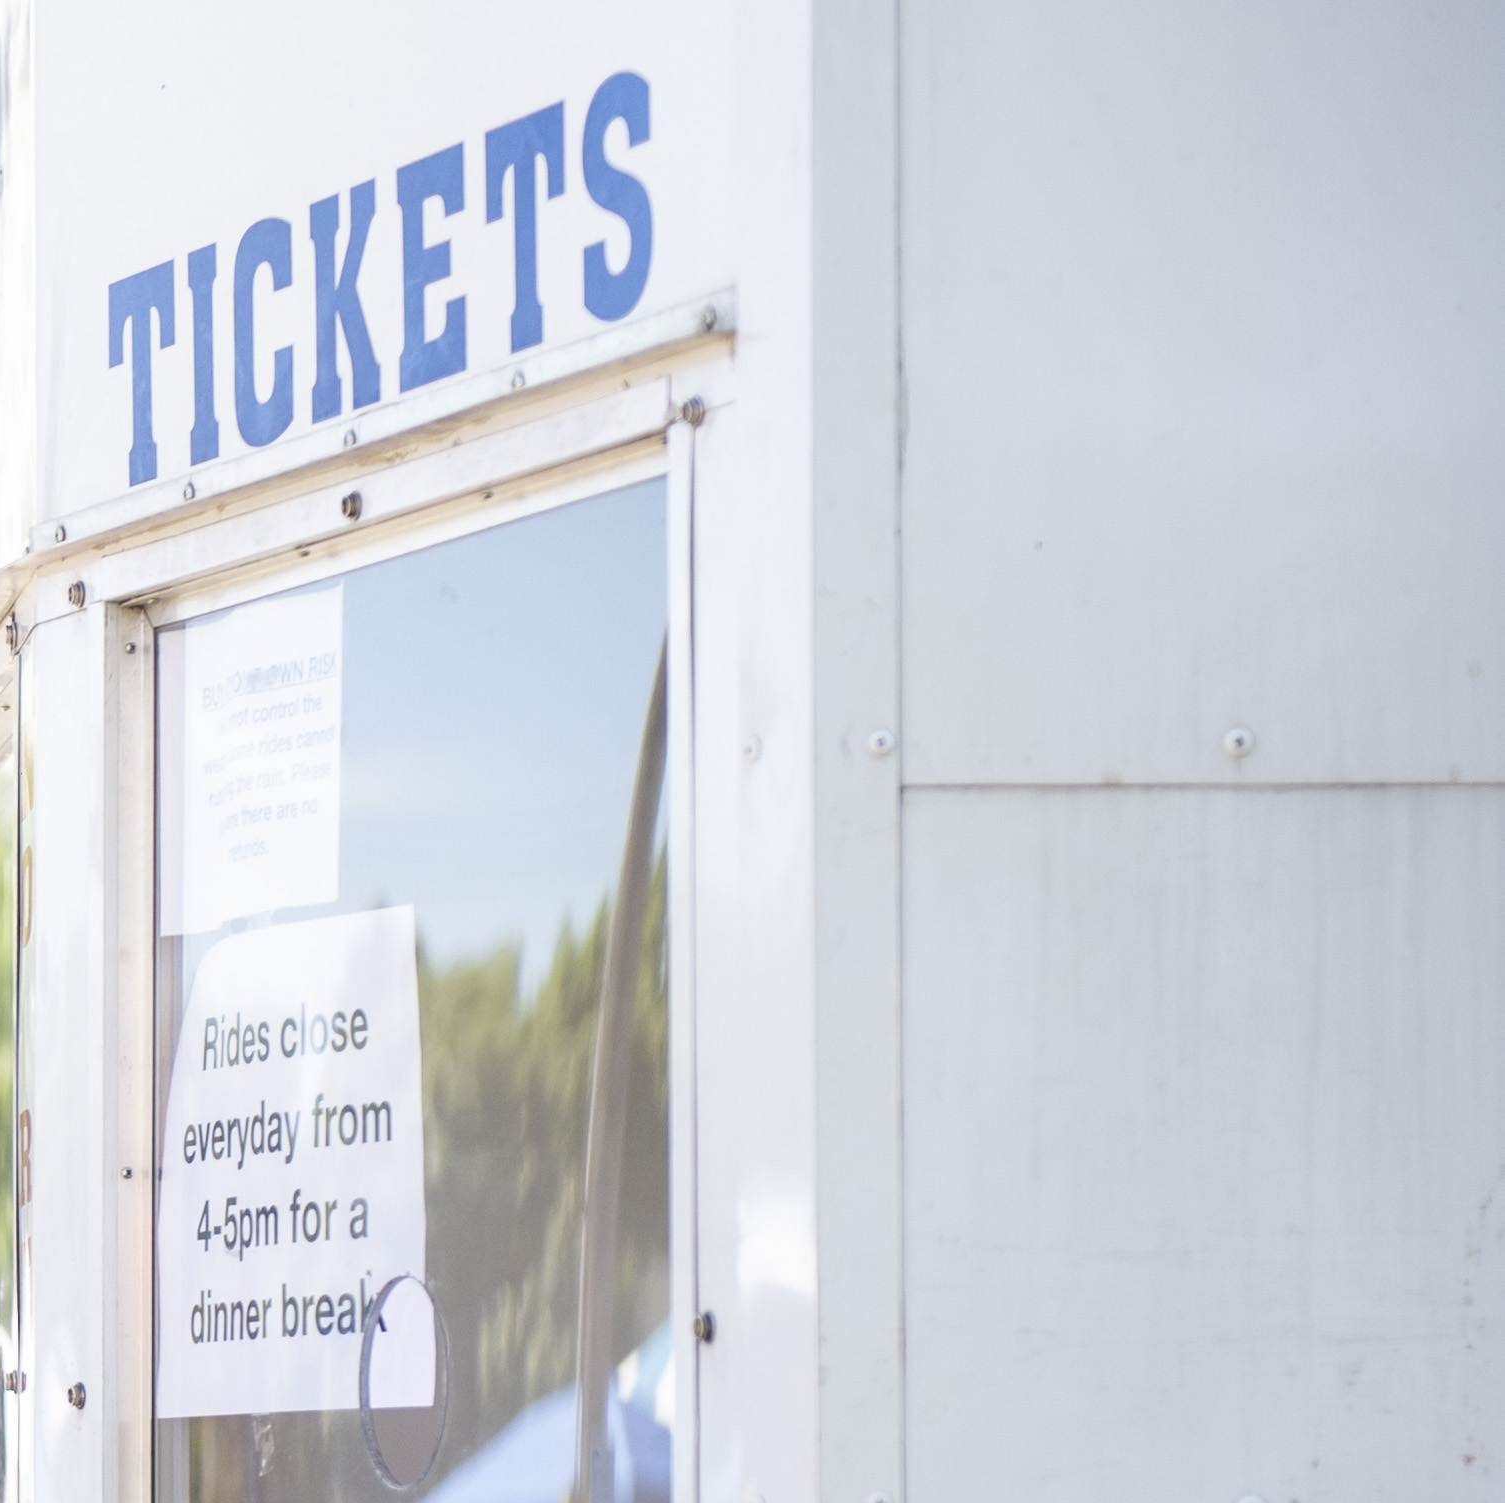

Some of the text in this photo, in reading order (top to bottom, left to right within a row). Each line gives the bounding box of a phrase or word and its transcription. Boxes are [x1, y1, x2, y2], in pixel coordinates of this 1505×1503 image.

[108, 69, 653, 488] TICKETS
[252, 696, 299, 724] control
[303, 693, 323, 714] the
[259, 731, 293, 755] rides
[291, 760, 332, 784] Please
[241, 804, 273, 826] there
[276, 801, 298, 821] are
[302, 798, 319, 816] no
[202, 1002, 369, 1071] Rides close
[183, 1093, 392, 1170] everyday from
[197, 1189, 369, 1261] 4-5pm for a
[190, 1276, 388, 1344] dinner break
